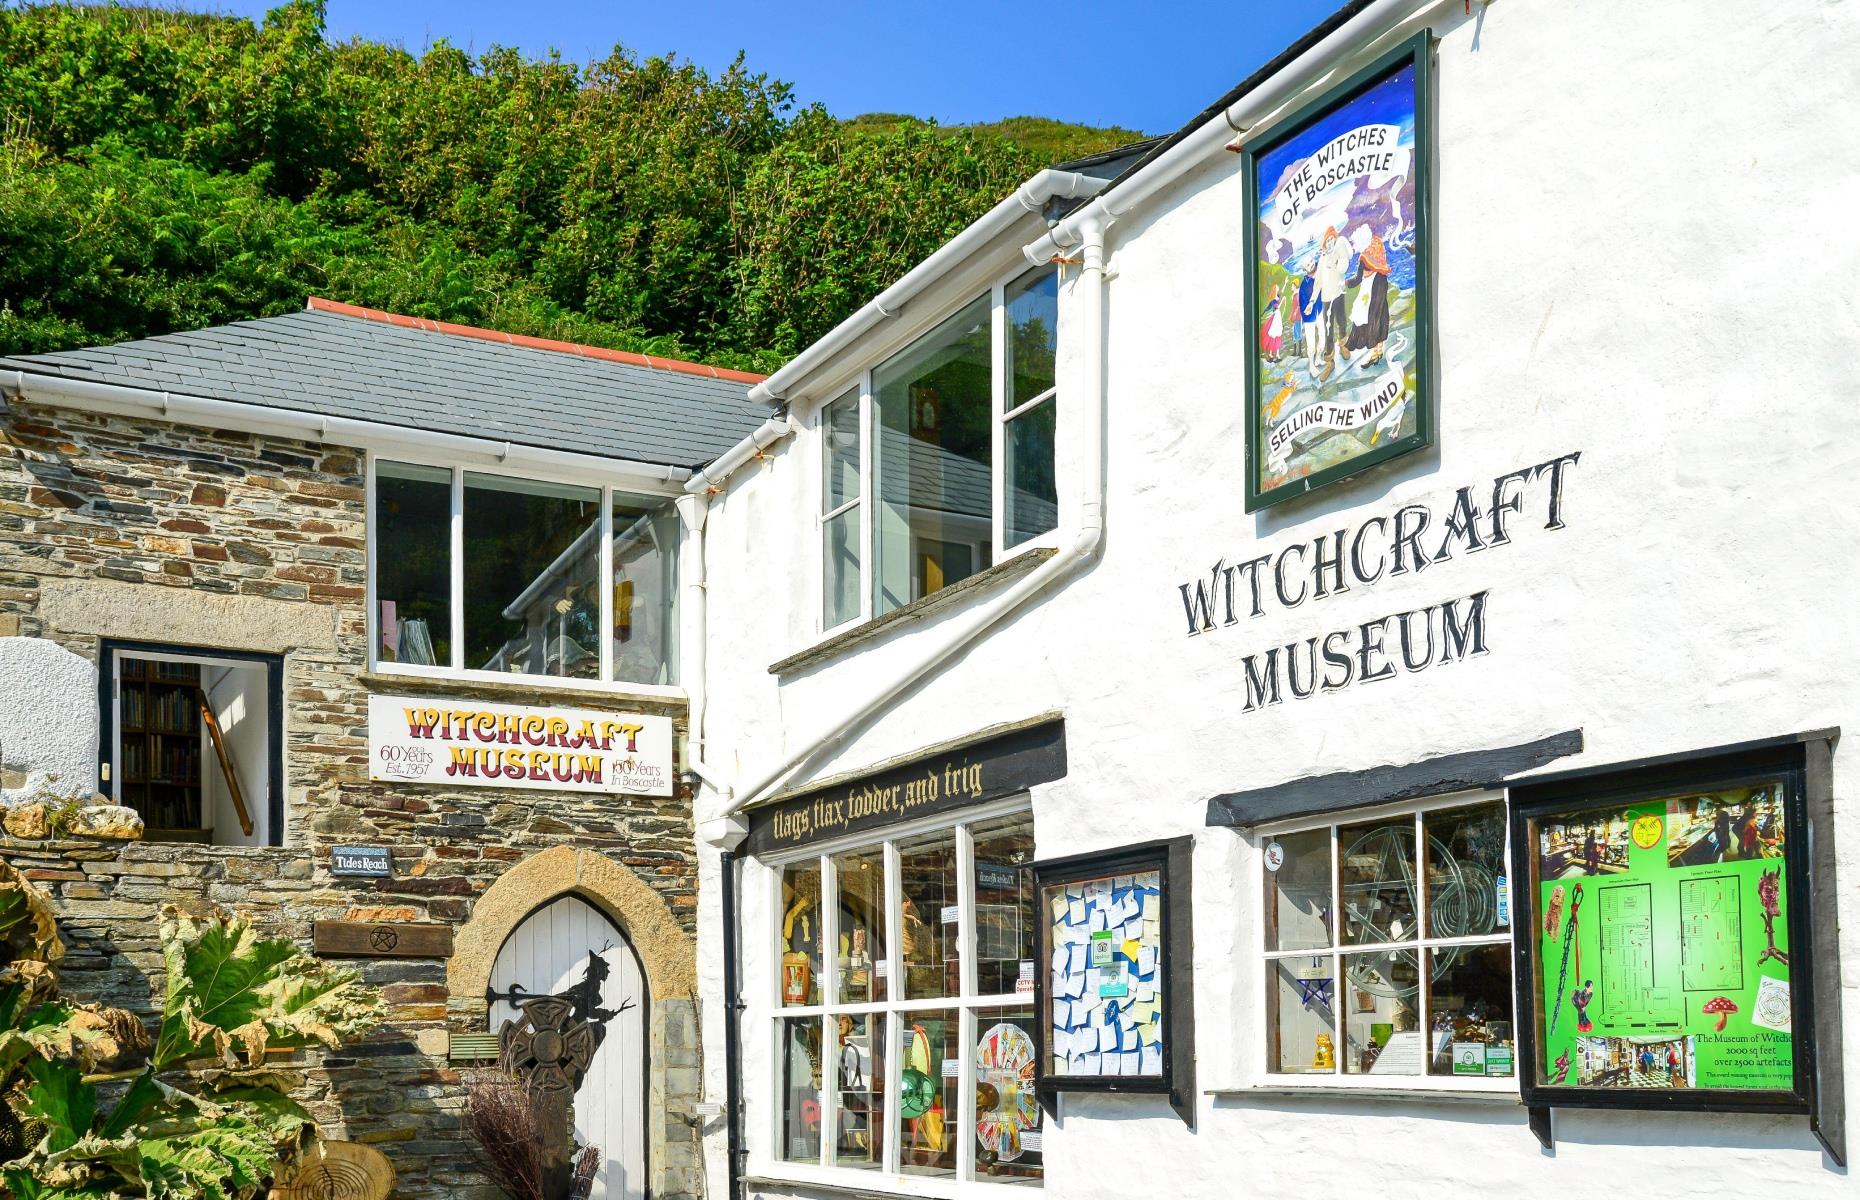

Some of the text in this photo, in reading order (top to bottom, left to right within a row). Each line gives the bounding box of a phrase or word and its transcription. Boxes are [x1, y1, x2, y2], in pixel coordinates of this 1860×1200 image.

[1284, 127, 1387, 199] THE WITCHES
[1282, 153, 1393, 226] OF BOSCASTLE
[1271, 381, 1398, 452] SELLING THE WIND
[1178, 450, 1582, 637] WITCHCRAFT
[1241, 588, 1492, 714] MUSEUM
[402, 707, 643, 752] WITCHCRAFT
[380, 744, 434, 764] 60 Years
[445, 745, 605, 784] MUSEUM
[632, 759, 661, 776] Years
[622, 775, 665, 788] Boscastle
[905, 769, 938, 807] and
[336, 856, 388, 871] Tides Reach
[1696, 1033, 1712, 1043] The
[1714, 1033, 1748, 1043] Museum
[1750, 1033, 1760, 1043] of
[1726, 1045, 1776, 1059] 2000 sq feet
[1714, 1056, 1792, 1069] over 2500 artefacts
